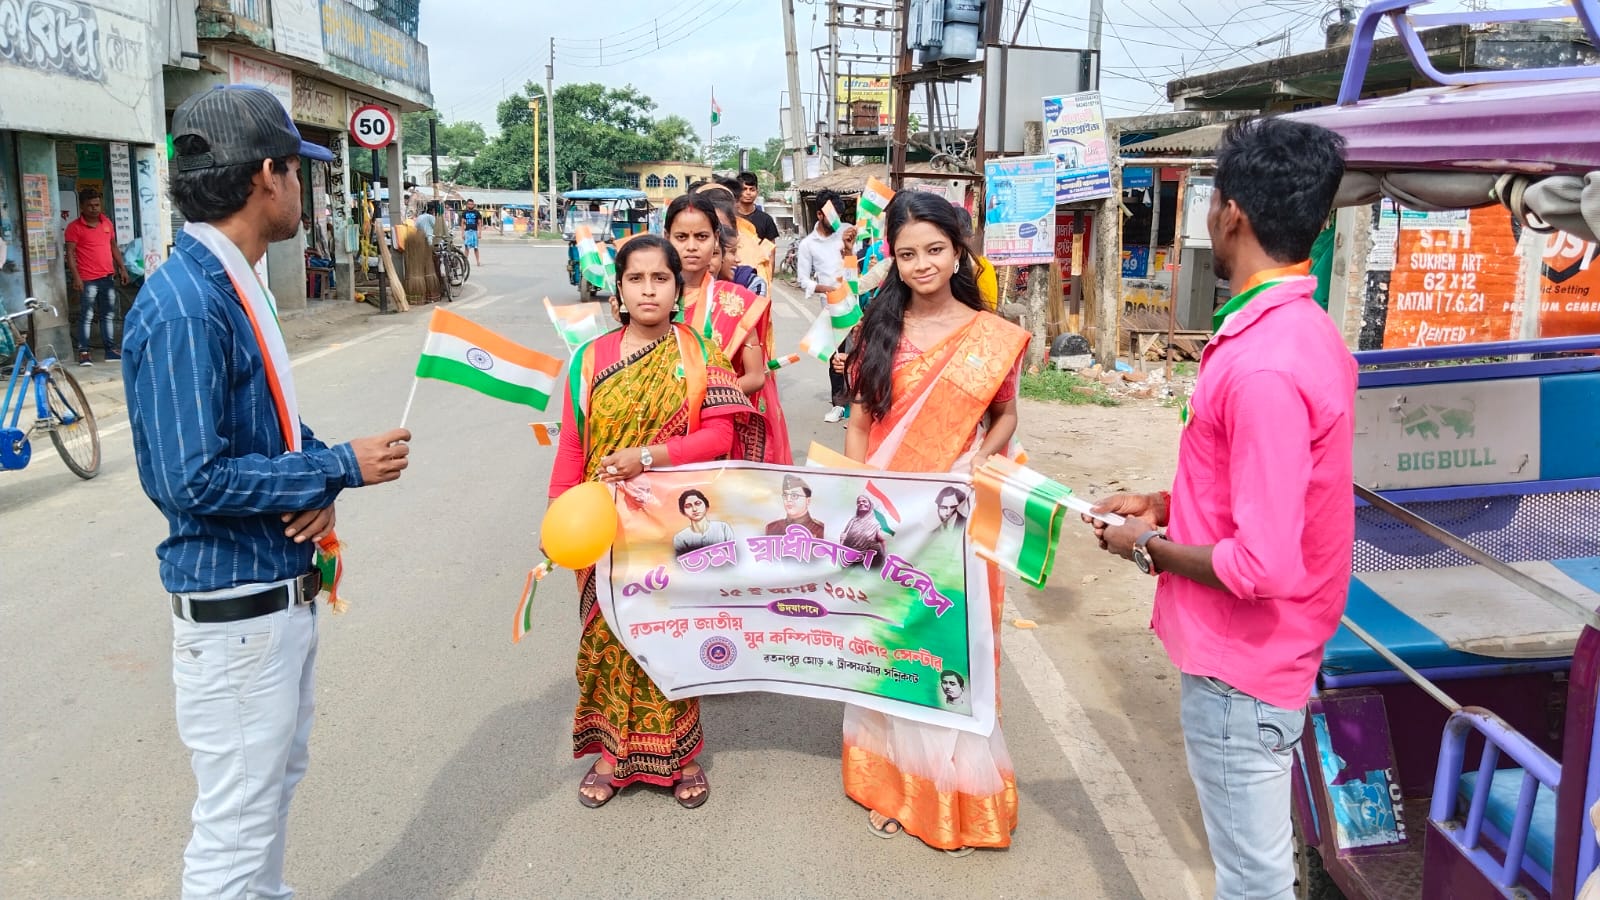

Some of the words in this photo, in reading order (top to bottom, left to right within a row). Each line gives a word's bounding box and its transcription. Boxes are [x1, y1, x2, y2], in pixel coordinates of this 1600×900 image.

[359, 118, 386, 136] 50
[1410, 252, 1457, 271] SUKHEN
[1461, 254, 1483, 271] ART
[1554, 285, 1590, 296] Setting
[1397, 291, 1434, 311] RATAN
[1565, 302, 1600, 312] CEME
[677, 540, 737, 573] তম
[746, 524, 878, 570] স্বাধীনতা
[879, 554, 955, 618] দিবস
[719, 587, 744, 597] ১৫
[823, 581, 871, 605] ২০২২
[629, 617, 689, 640] রতনপুর
[693, 611, 744, 631] জাতীয়
[743, 630, 765, 651] যুব
[769, 627, 844, 650] কম্পিউটার
[848, 635, 889, 659] ট্রেনিং
[892, 647, 943, 673] সেন্টার
[763, 653, 800, 667] রতনপুর
[802, 655, 825, 668] মোড়
